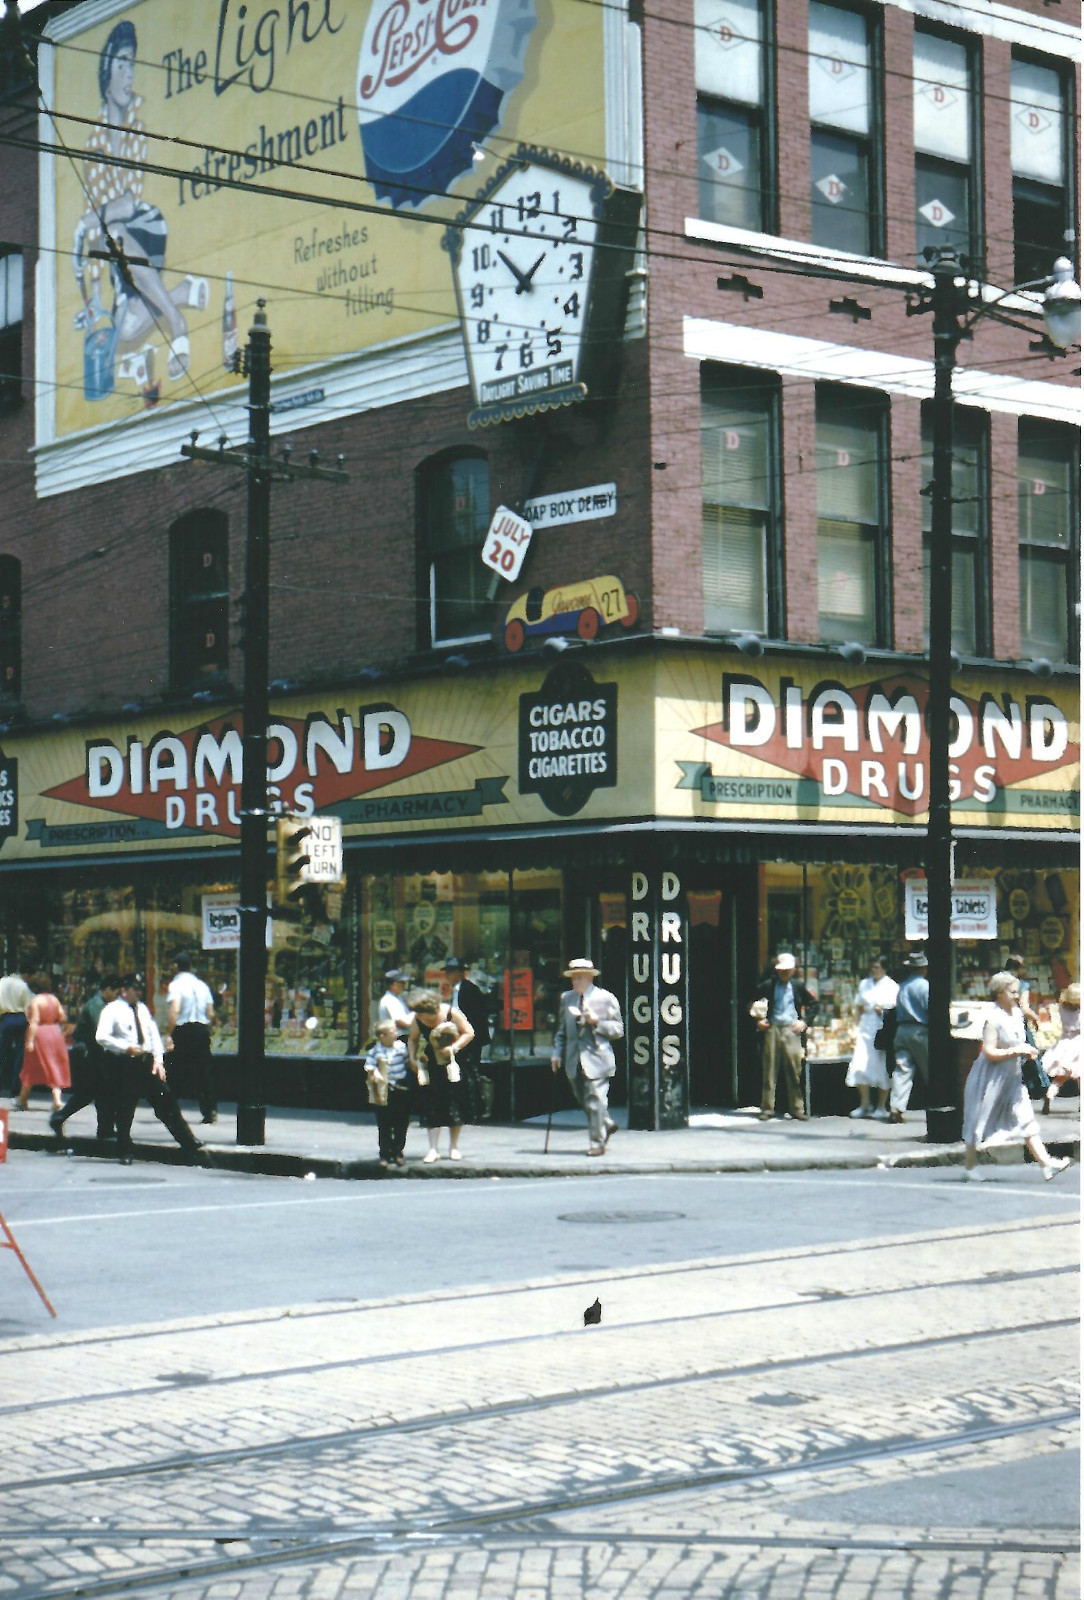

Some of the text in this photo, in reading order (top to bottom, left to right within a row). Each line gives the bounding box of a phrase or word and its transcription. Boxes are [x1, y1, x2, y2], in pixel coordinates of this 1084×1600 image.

[720, 25, 732, 42] D
[163, 48, 207, 99] The
[831, 59, 843, 75] D
[934, 86, 945, 103] D
[1029, 112, 1039, 129] D
[718, 154, 730, 171] D
[829, 180, 841, 197] D
[517, 191, 541, 222] 12
[552, 190, 561, 216] 1
[933, 205, 944, 223] D
[294, 221, 369, 264] Refreshes
[562, 217, 578, 243] 2
[472, 243, 491, 272] 10
[568, 252, 584, 281] 3
[316, 253, 378, 292] without
[344, 285, 395, 318] filling
[471, 282, 485, 309] 9
[563, 291, 580, 319] 4
[477, 318, 491, 344] 8
[546, 326, 563, 358] 5
[494, 343, 509, 371] 7
[519, 338, 535, 368] 6
[517, 372, 549, 394] SAVING
[549, 365, 572, 386] TIME
[725, 430, 740, 450] D
[550, 501, 573, 519] BOX
[578, 490, 615, 513] DERBY
[493, 515, 530, 547] JULY
[489, 540, 516, 573] 20
[601, 588, 621, 617] 27
[206, 633, 215, 648] D
[529, 698, 607, 728] CIGARS
[728, 683, 1068, 761] DIAMOND
[529, 725, 606, 753] TOBACCO
[88, 710, 412, 798] DIAMOND
[528, 751, 608, 779] CIGARETTES
[709, 781, 792, 800] PRESCRIPTION
[310, 825, 331, 841] NO
[631, 871, 652, 1066] DRUGS
[660, 871, 683, 1066] DRUGS
